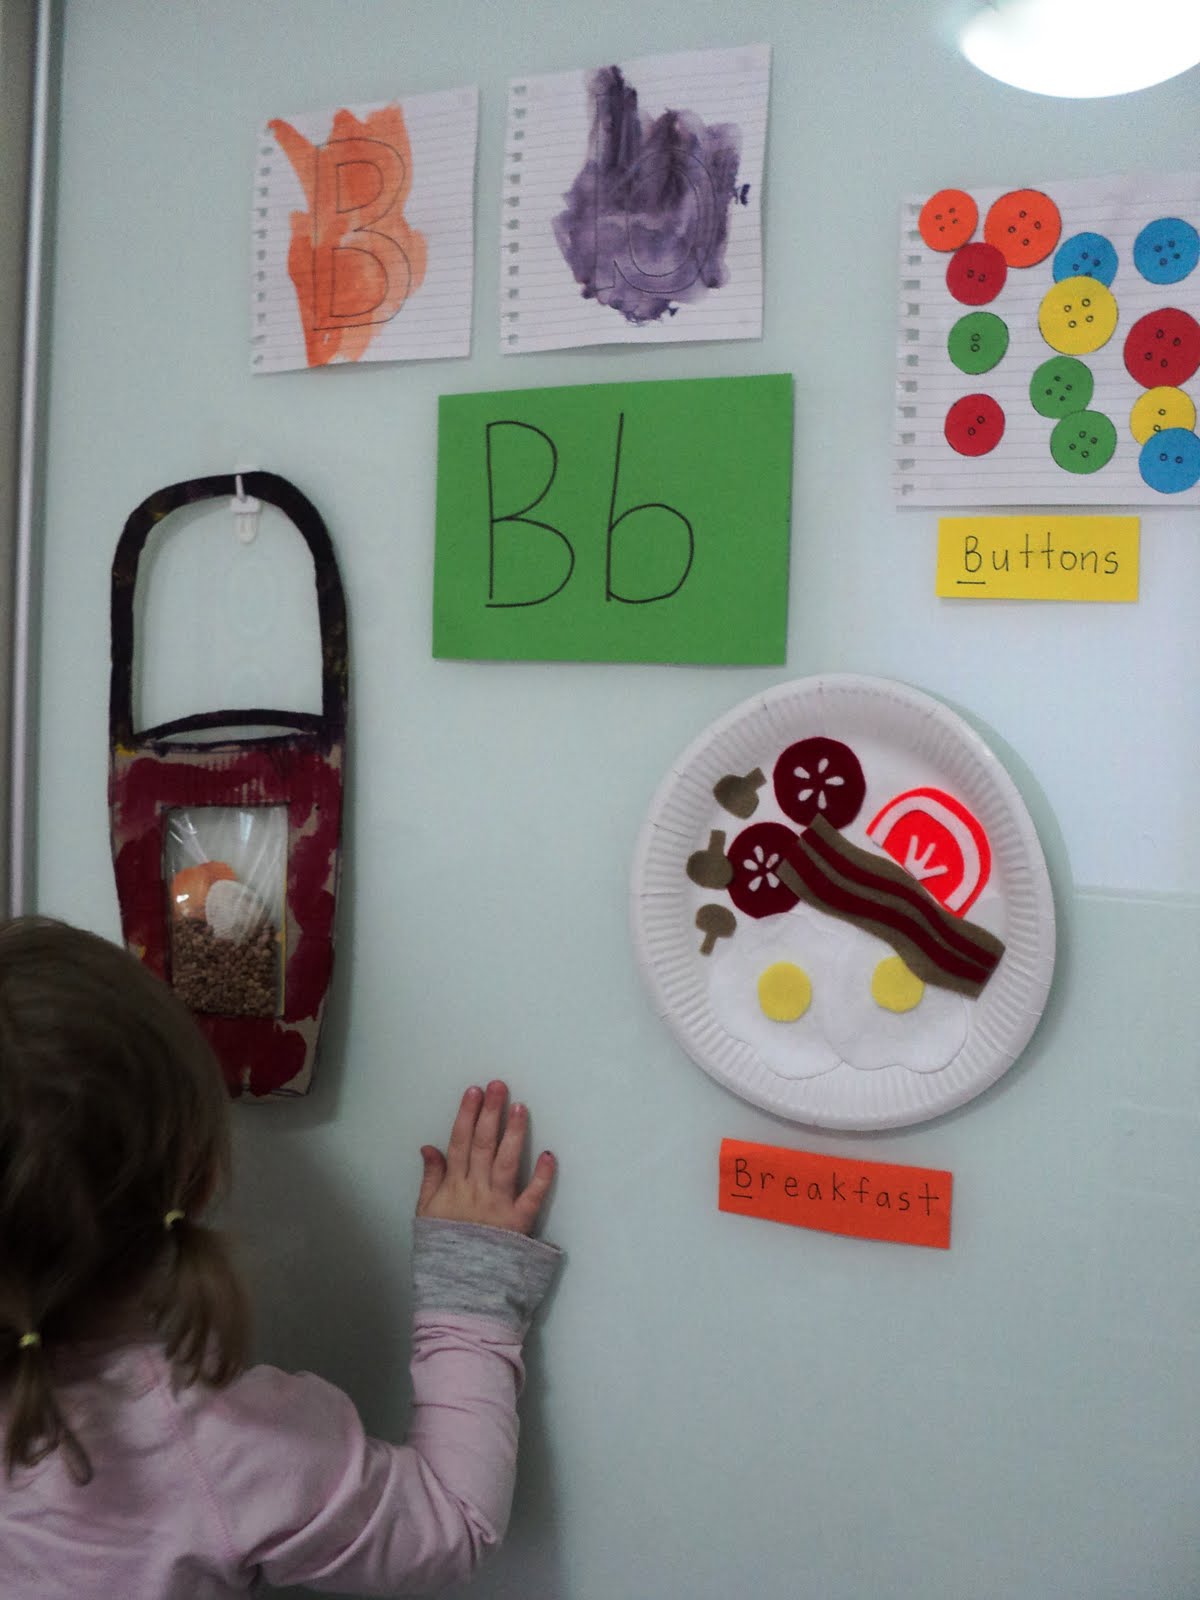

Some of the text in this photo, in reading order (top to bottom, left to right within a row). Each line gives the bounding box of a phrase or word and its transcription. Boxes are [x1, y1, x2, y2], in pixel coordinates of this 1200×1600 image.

[312, 137, 412, 332] B
[963, 531, 1120, 575] Buttons
[733, 1157, 940, 1217] Breakfast
